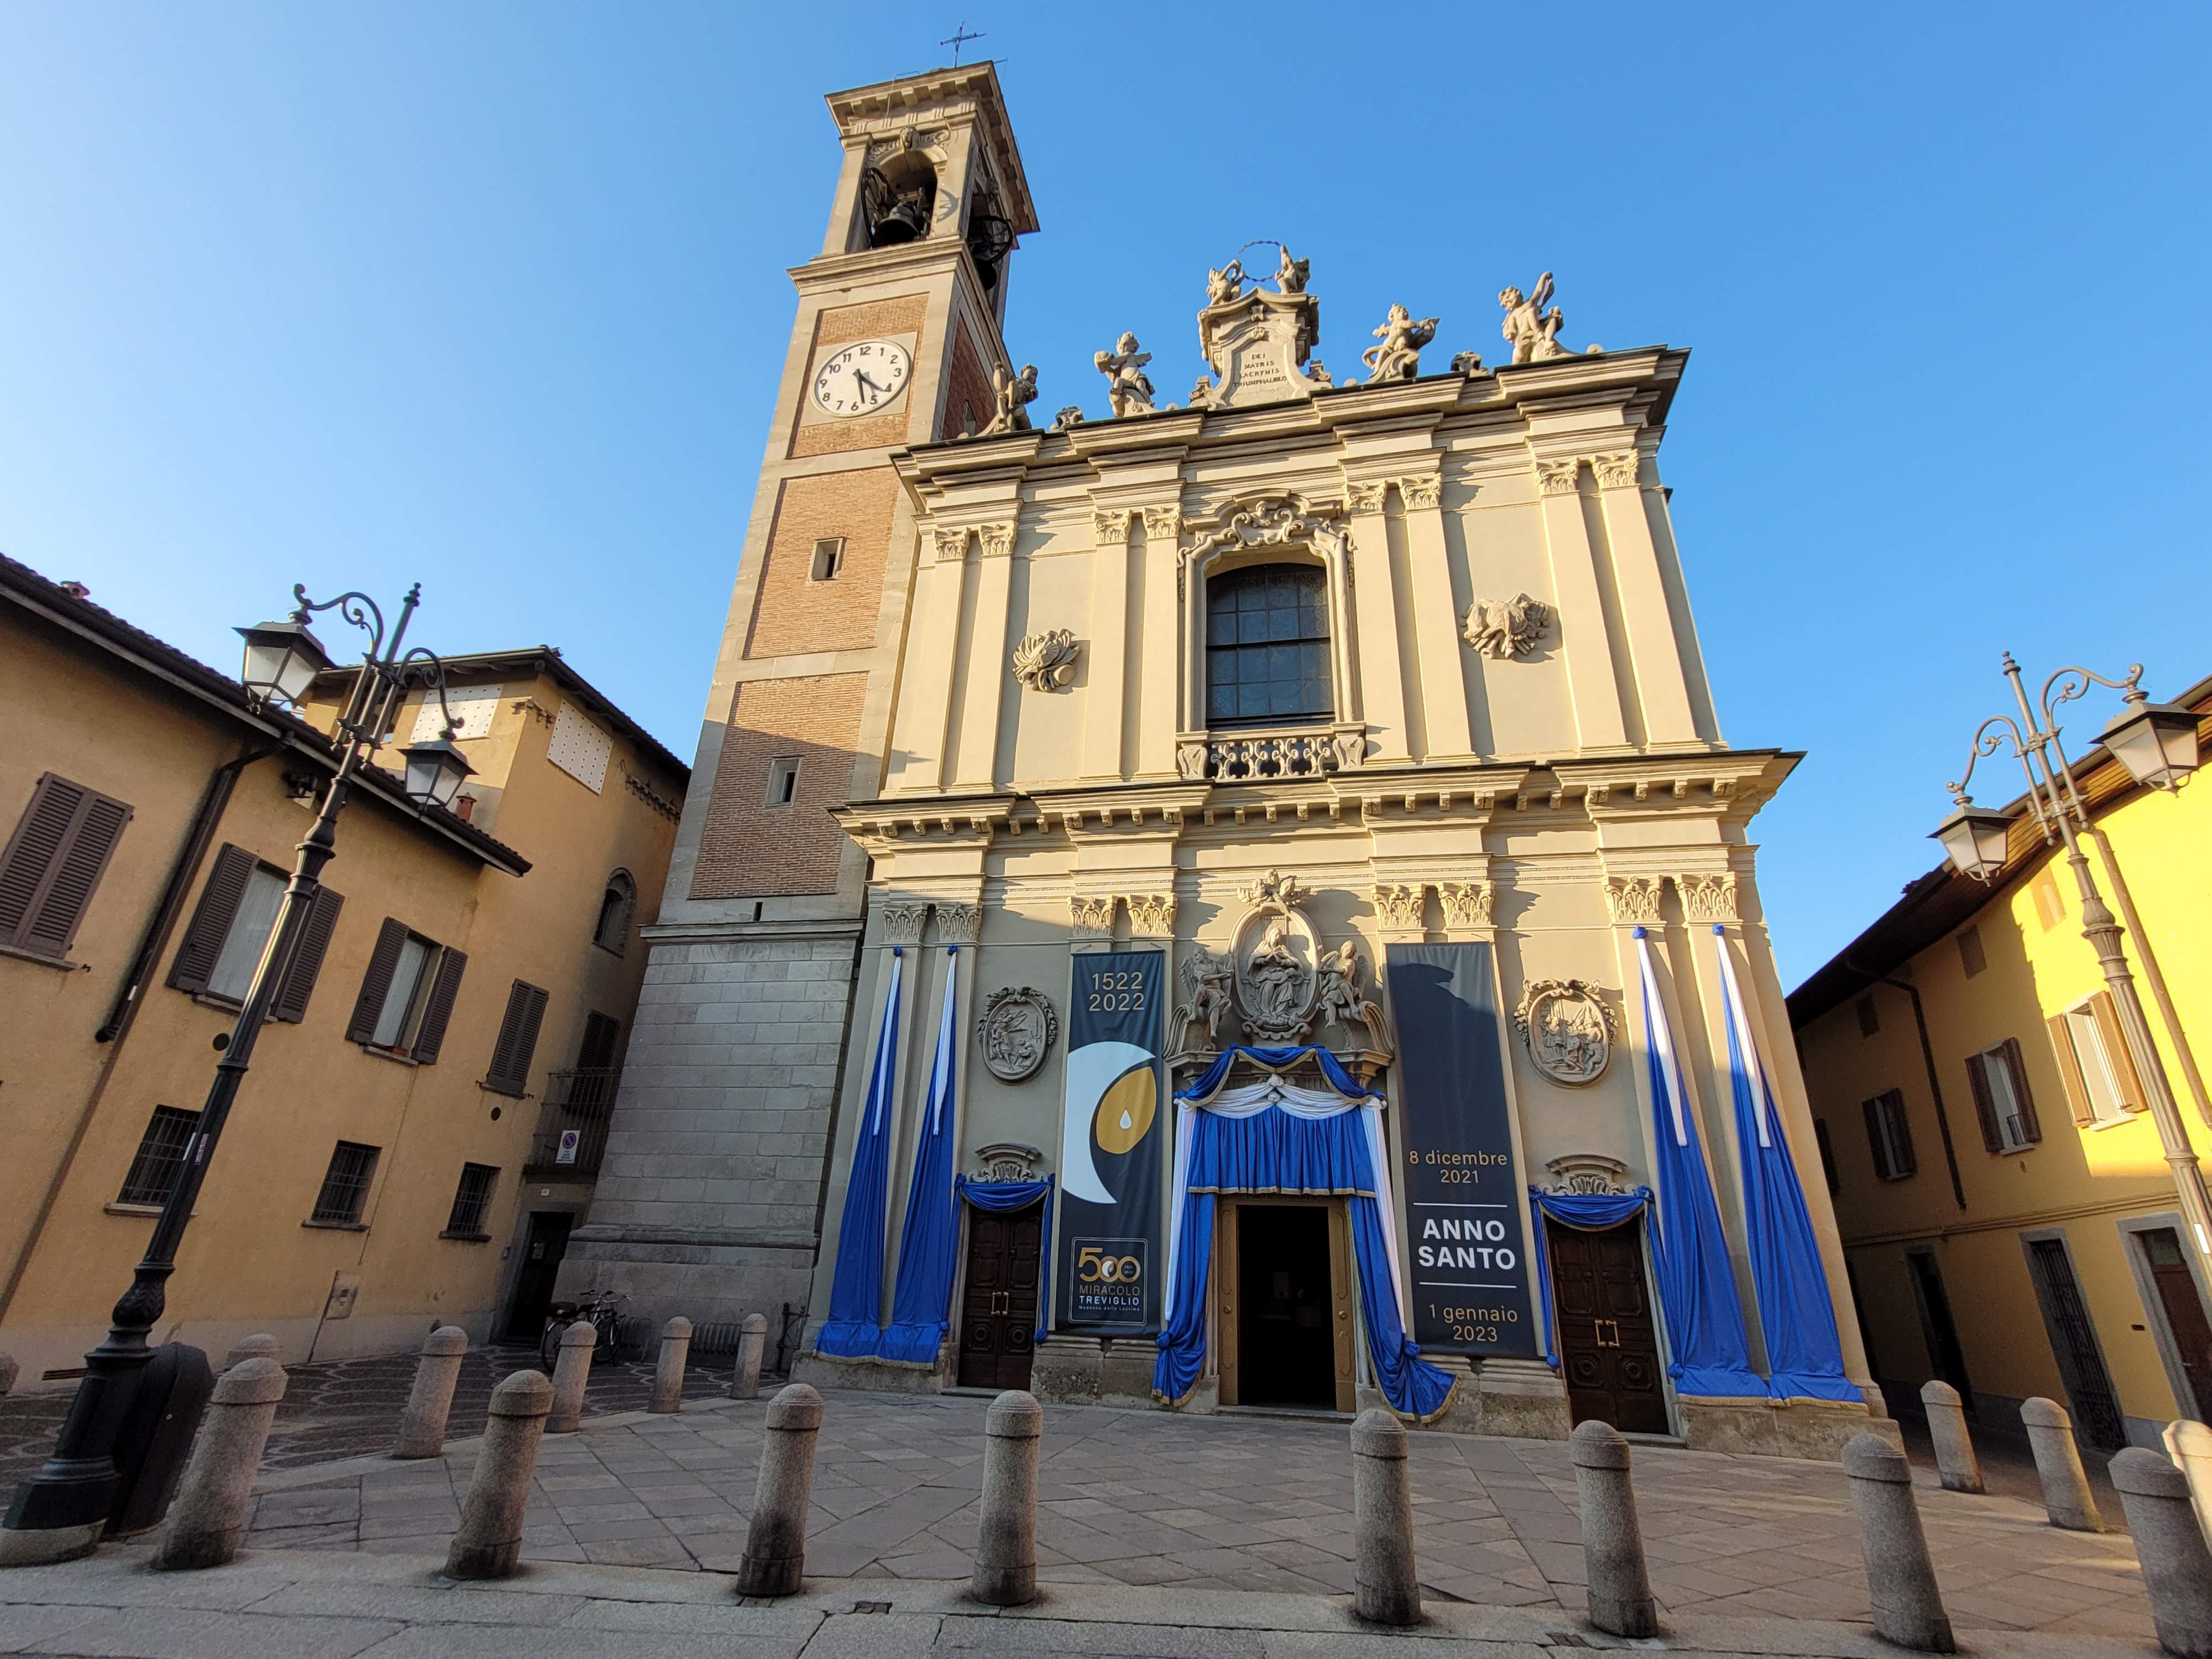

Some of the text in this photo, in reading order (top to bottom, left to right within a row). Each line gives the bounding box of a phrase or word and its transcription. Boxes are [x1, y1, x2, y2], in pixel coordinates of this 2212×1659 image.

[859, 346, 871, 356] 12
[880, 347, 885, 357] 1
[843, 353, 852, 363] 11
[890, 354, 898, 364] 2
[829, 364, 841, 374] 10
[1244, 361, 1275, 369] MATRIS
[893, 368, 902, 377] 3
[820, 379, 828, 388] 9
[885, 383, 892, 393] 4
[822, 393, 831, 402] 8
[869, 395, 878, 405] 5
[836, 400, 844, 410] 7
[851, 401, 859, 411] 6
[1092, 972, 1142, 990] 1522
[1089, 993, 1145, 1011] 2022
[1410, 1150, 1507, 1166] 8 dicembre
[1440, 1170, 1478, 1184] 2021
[1423, 1218, 1505, 1241] ANNO
[1418, 1245, 1516, 1270] SANTO
[1078, 1247, 1141, 1282] 500
[1079, 1285, 1140, 1296] MIRACOLO
[1079, 1296, 1139, 1306] TREVIGLIO
[1430, 1304, 1517, 1323] 1 gennaio
[1453, 1325, 1498, 1342] 2023
